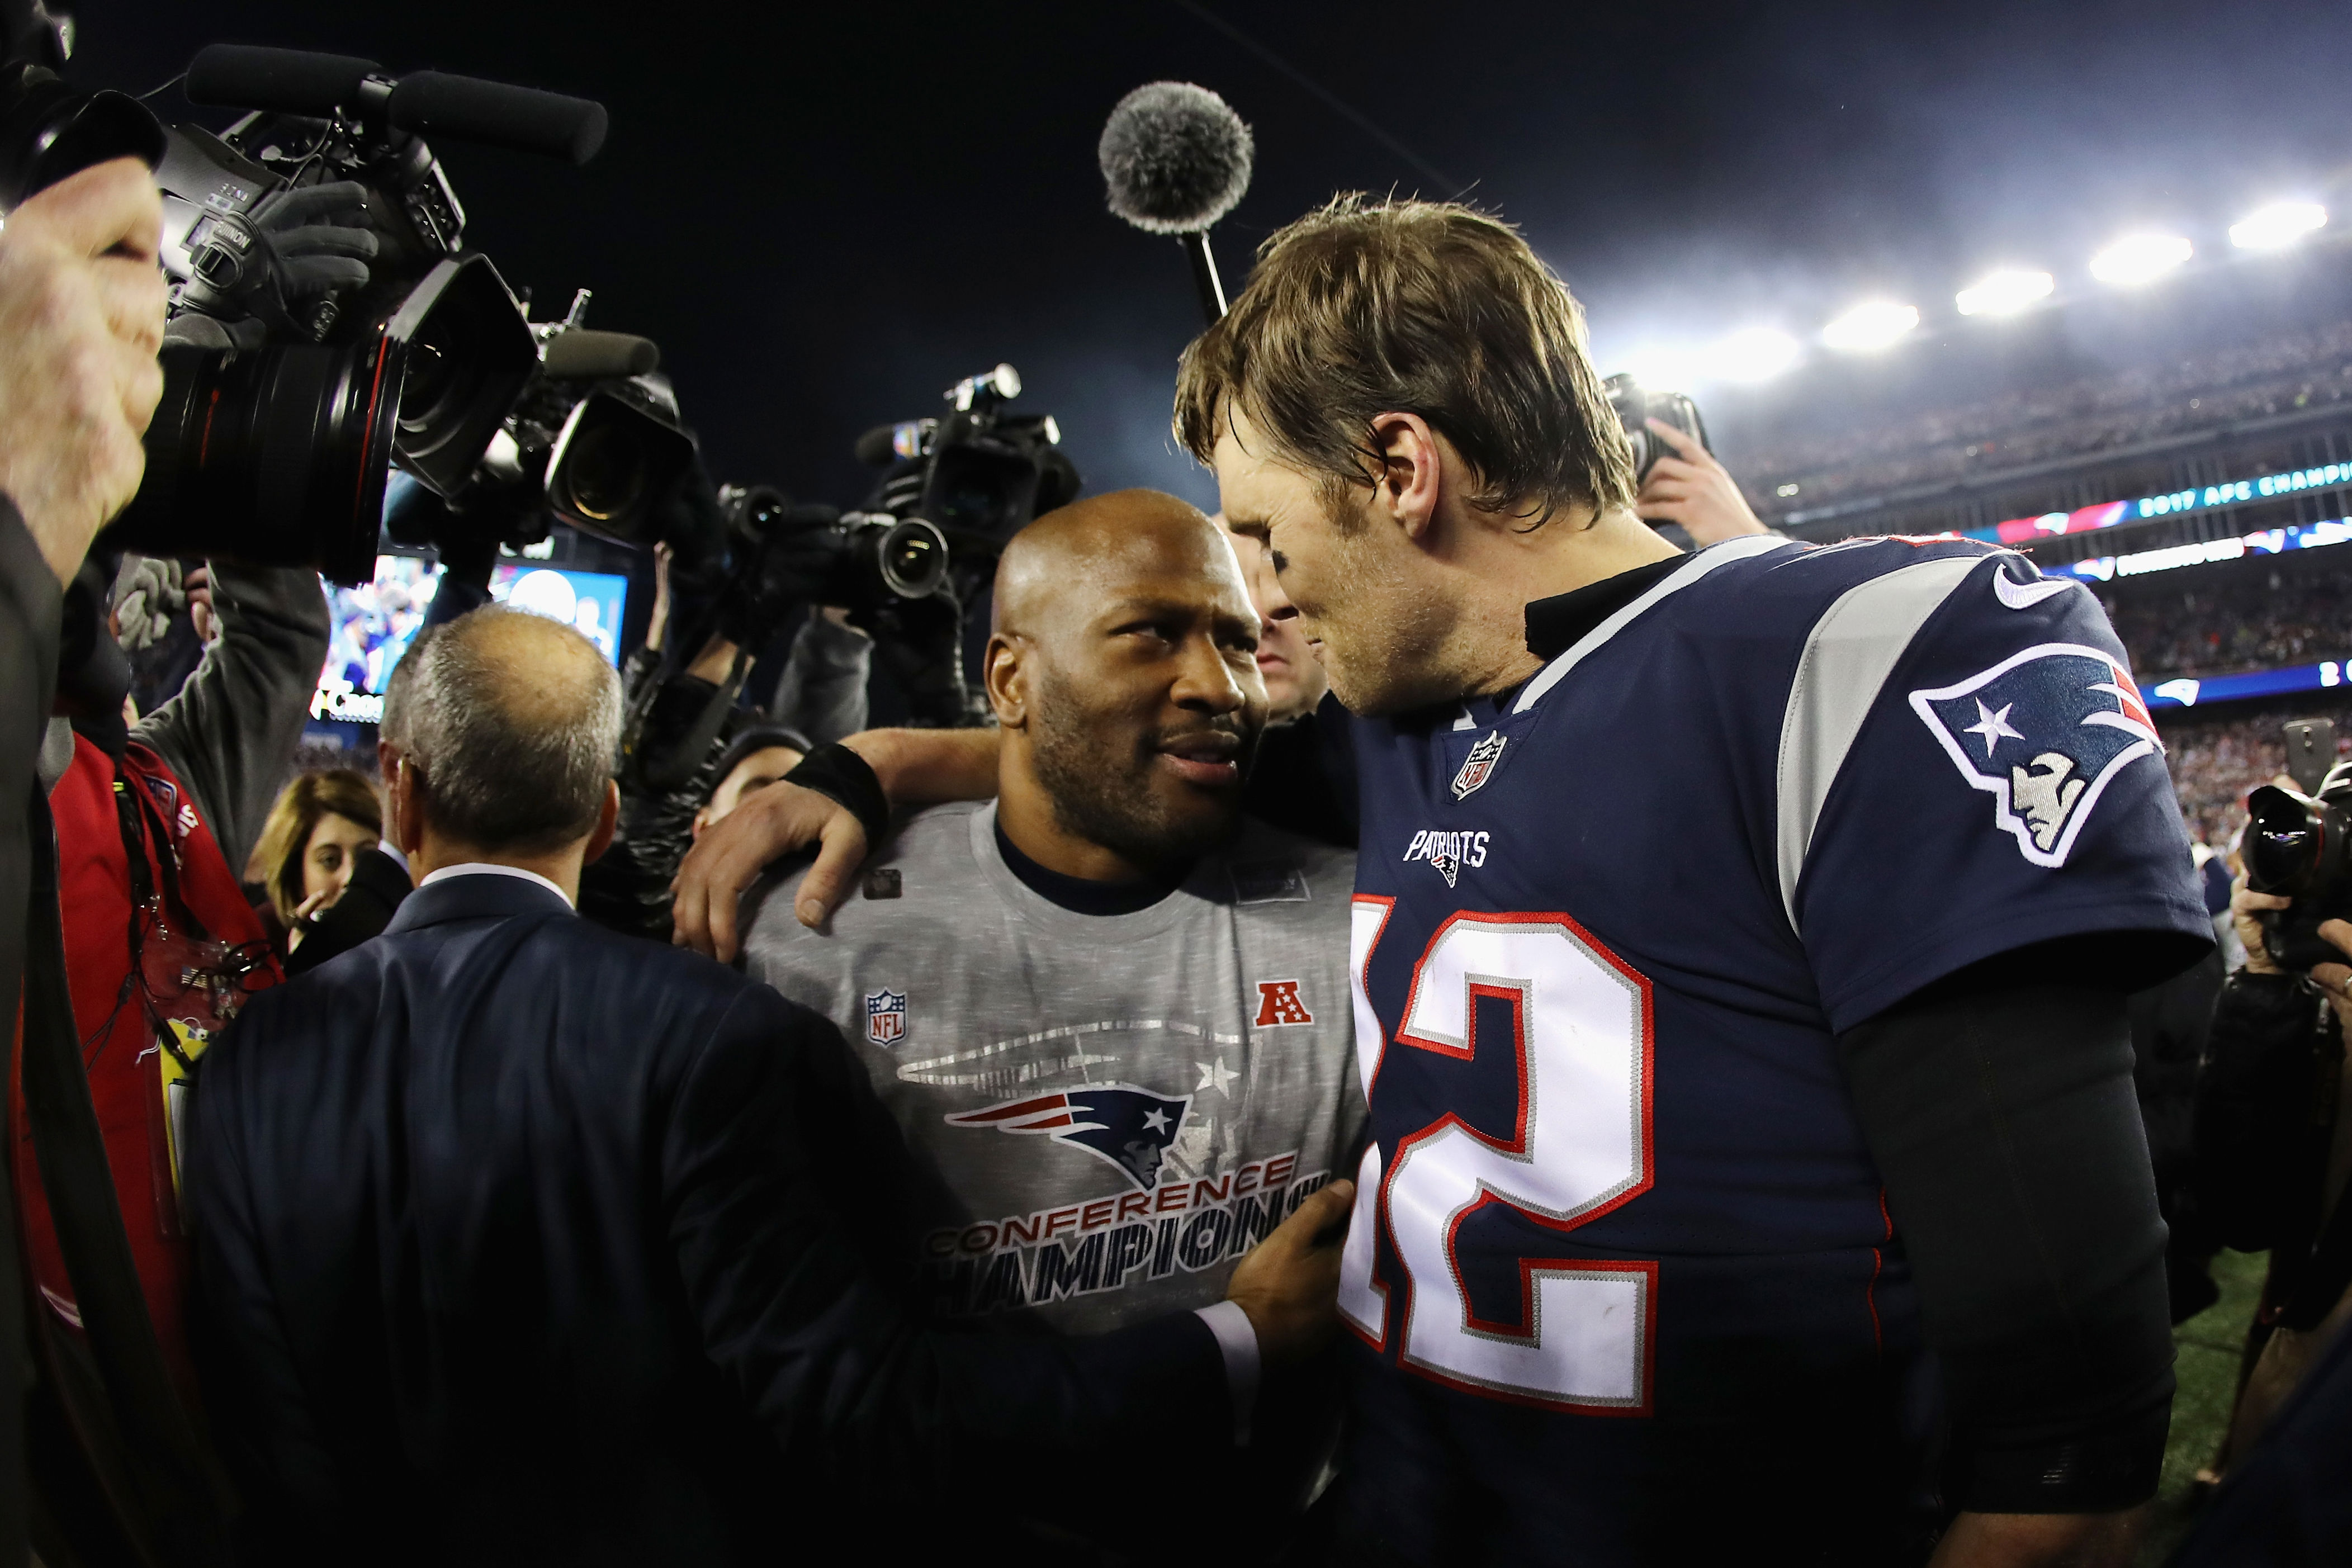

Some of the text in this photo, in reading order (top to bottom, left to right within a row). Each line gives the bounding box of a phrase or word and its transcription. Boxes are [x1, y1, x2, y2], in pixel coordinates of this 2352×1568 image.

[2258, 462, 2352, 496] CHAMPI
[1459, 762, 1488, 788] NFL
[1402, 830, 1490, 868] PATRIOTS
[872, 1013, 902, 1039] NFL
[924, 1150, 1297, 1261] CONFERENCE
[917, 1171, 1330, 1316] HAMPION
